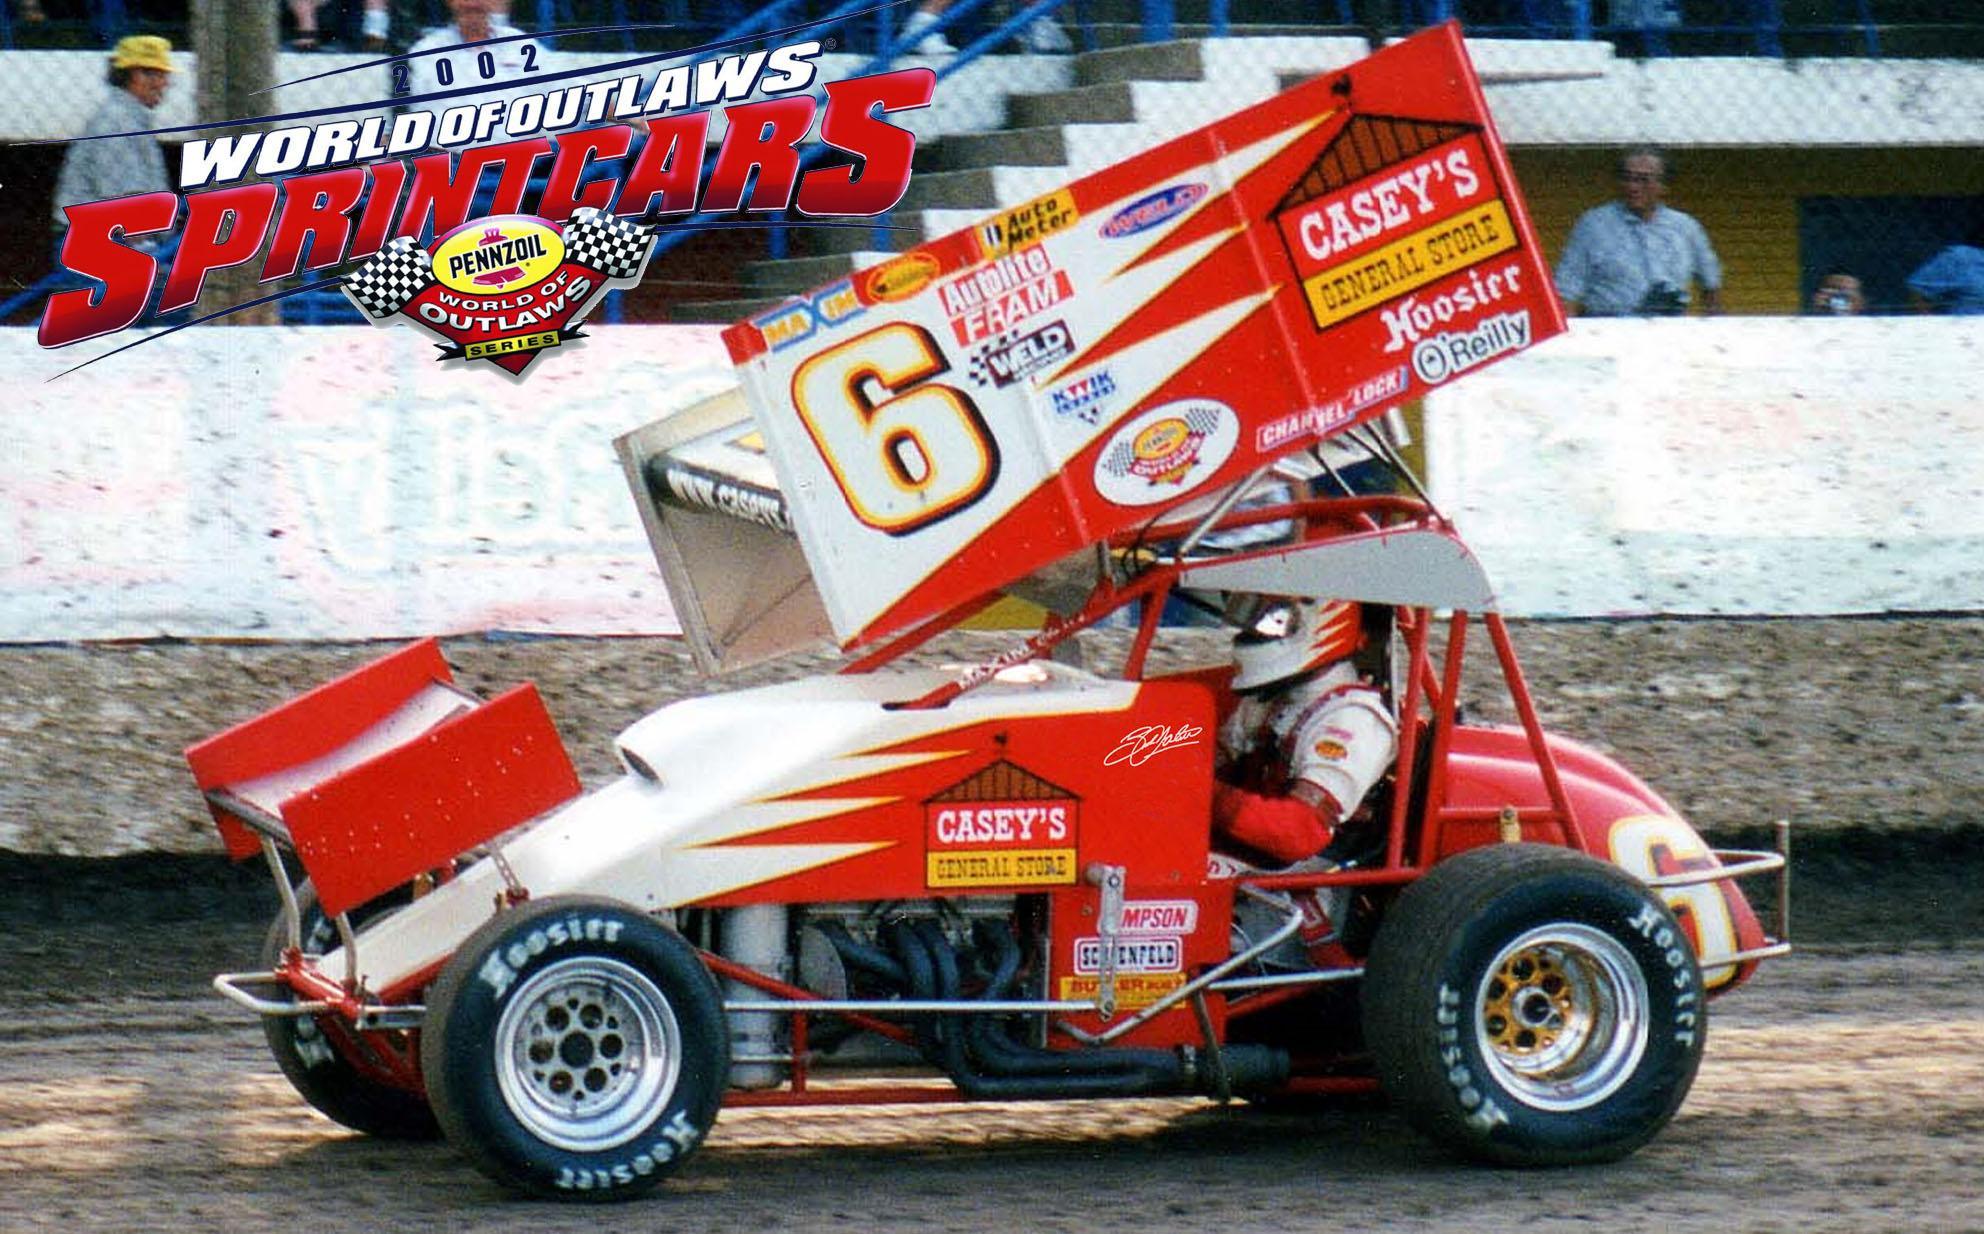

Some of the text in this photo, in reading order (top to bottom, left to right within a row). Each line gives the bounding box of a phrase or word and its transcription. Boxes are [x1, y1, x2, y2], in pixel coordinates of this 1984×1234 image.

[1008, 197, 1058, 228] Auto
[1008, 210, 1072, 249] Meter
[1300, 149, 1479, 260] CASEY'S
[944, 249, 1051, 315] Autolite
[1320, 214, 1499, 311] GENERAL STORE
[963, 276, 1062, 344] FRAM
[1380, 264, 1520, 352] Hoosier
[988, 324, 1069, 378] WELD
[1417, 316, 1529, 382] O'Reilly
[791, 320, 1000, 536] 6
[937, 807, 1066, 843] CASEY'S
[937, 855, 1066, 879] GENERAL STORE
[1608, 813, 1737, 990] 6
[1121, 907, 1188, 928] MPSON
[478, 918, 624, 998] Hoosier
[1627, 903, 1695, 1049] Hoosier
[1436, 983, 1511, 1134] Hoosier
[556, 1108, 702, 1190] Hoosier
